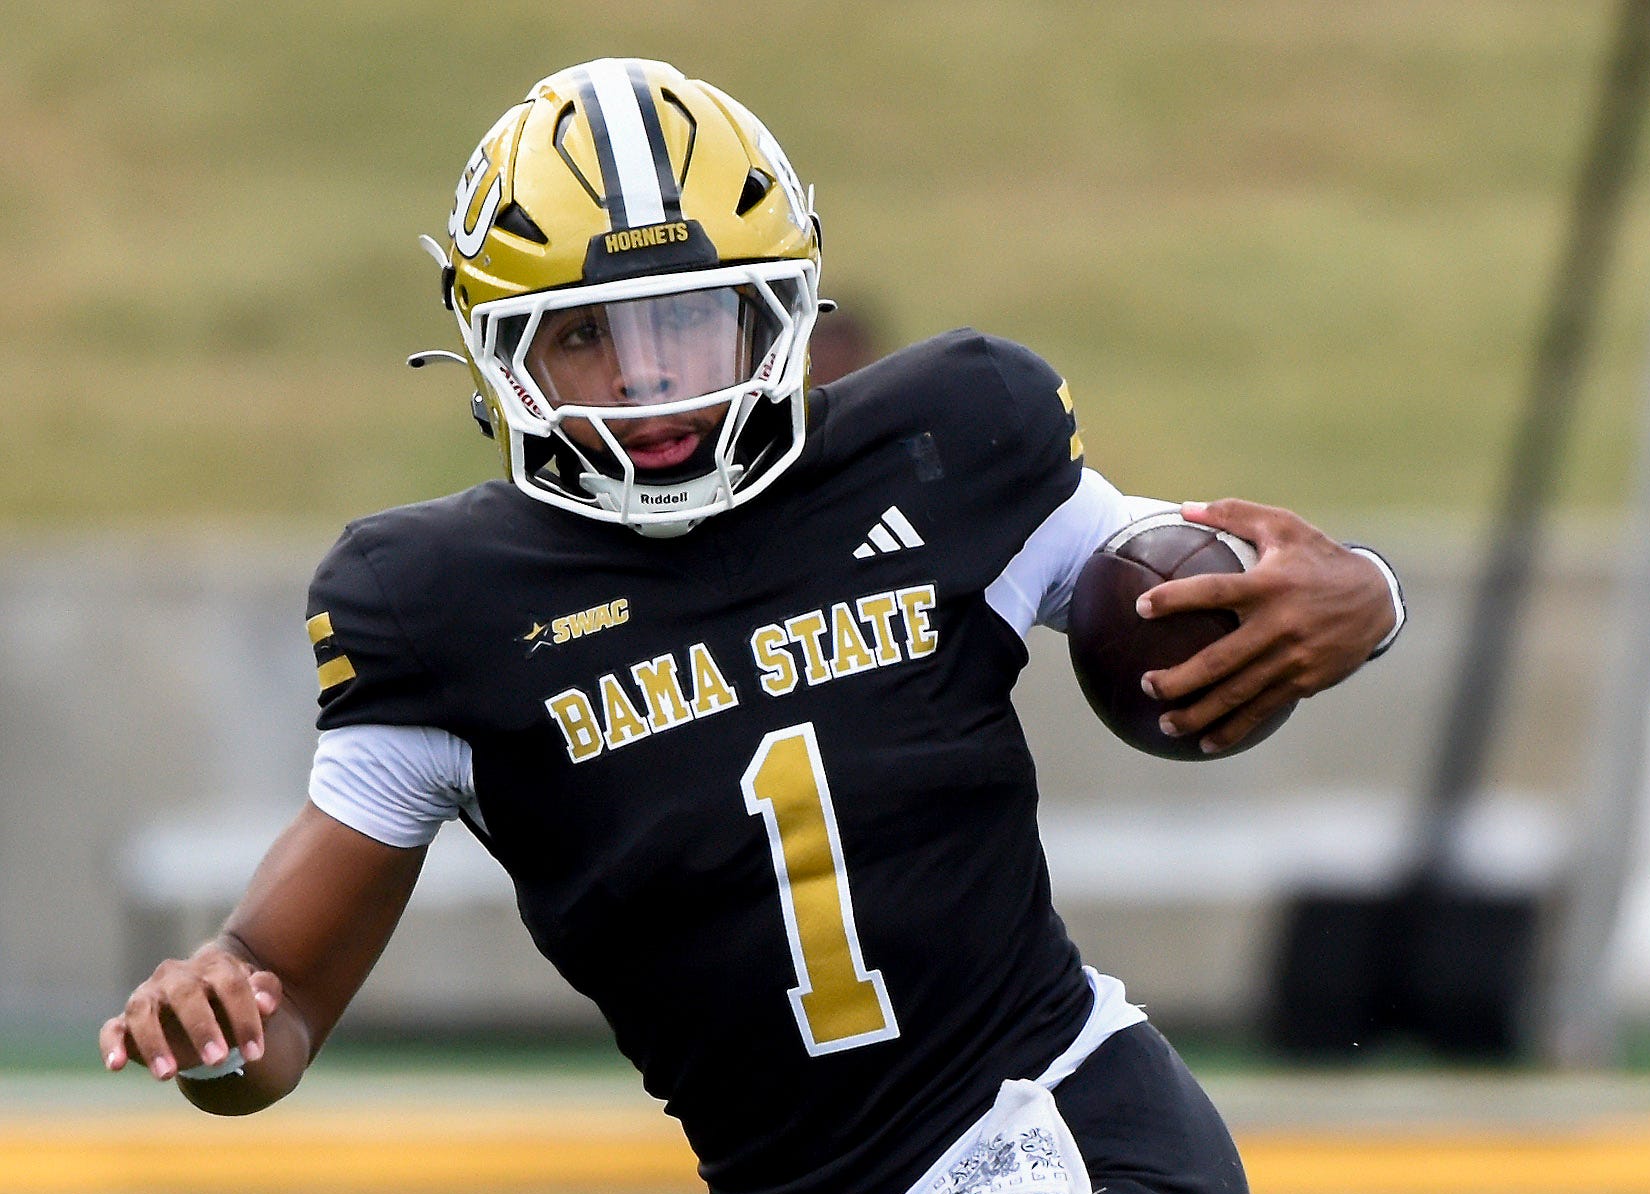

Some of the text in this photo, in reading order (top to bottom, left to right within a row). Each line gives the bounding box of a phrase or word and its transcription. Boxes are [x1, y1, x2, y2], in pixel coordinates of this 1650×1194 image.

[605, 222, 688, 253] HORNETS
[640, 491, 688, 505] Riddell
[551, 598, 631, 644] SWAC
[544, 584, 939, 764] BAMA STATE
[740, 721, 900, 1057] 1
